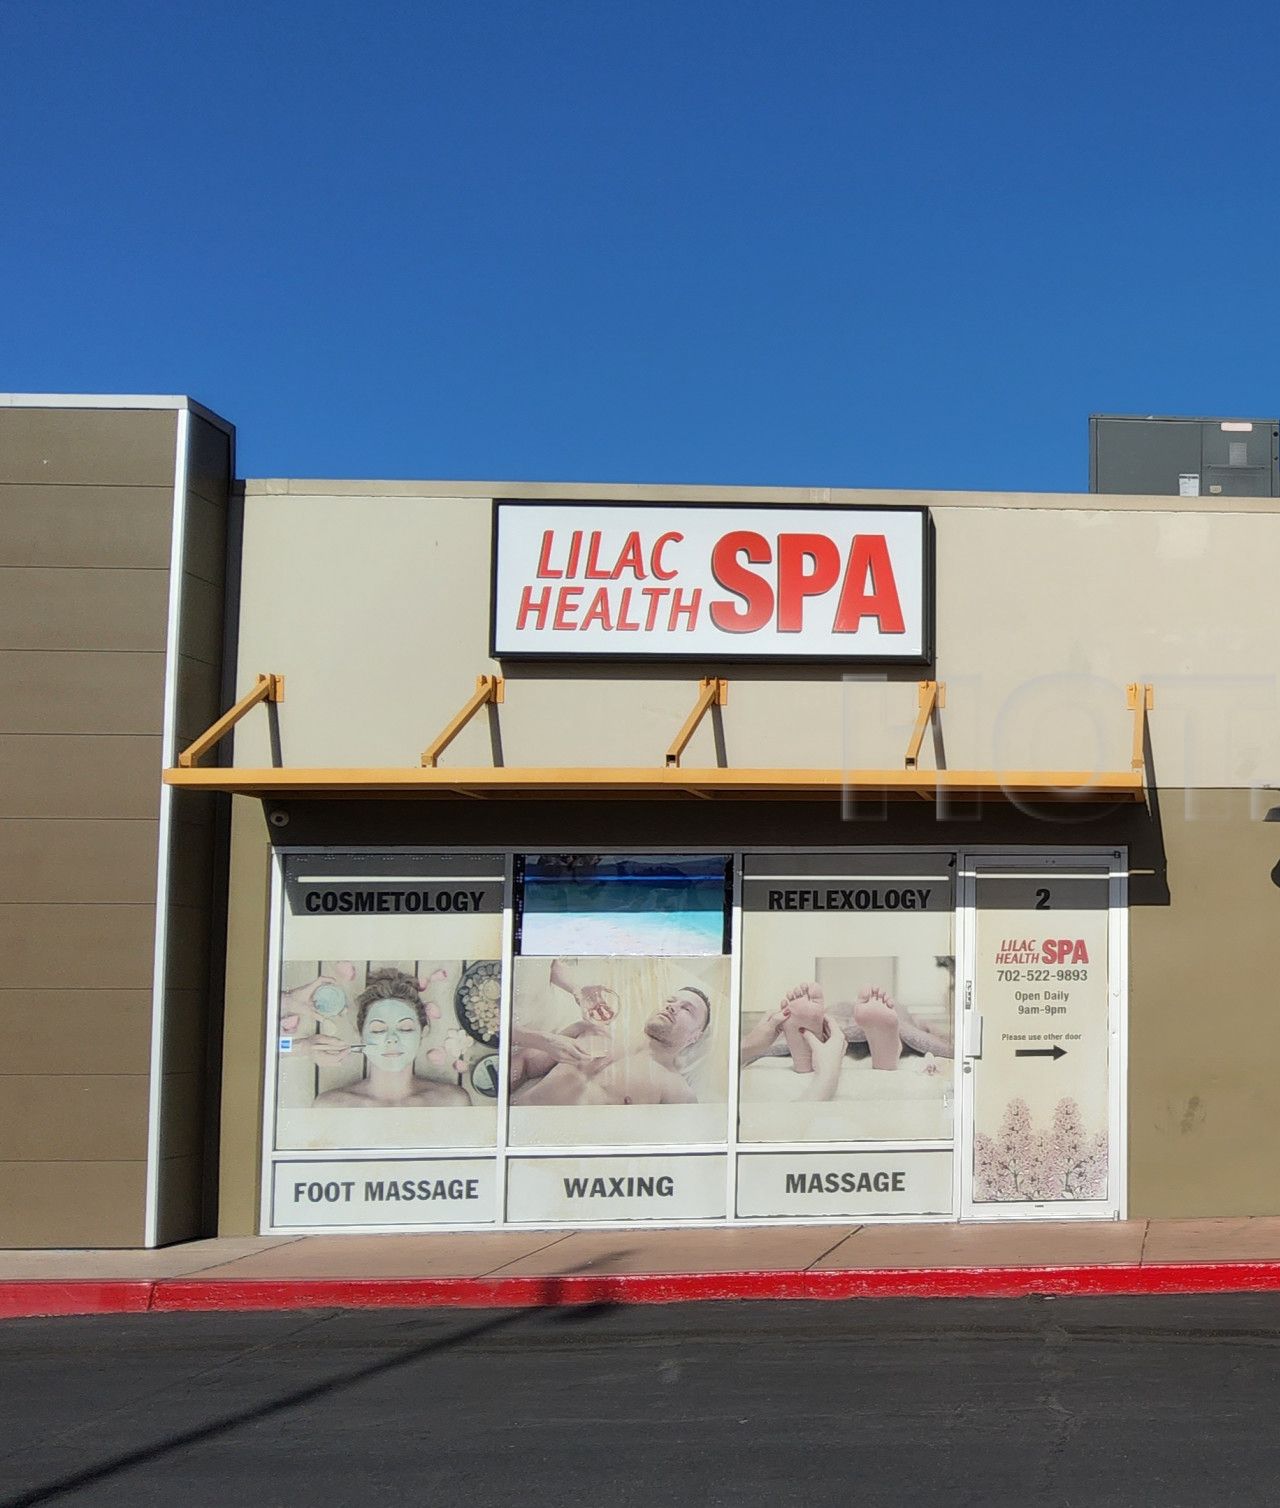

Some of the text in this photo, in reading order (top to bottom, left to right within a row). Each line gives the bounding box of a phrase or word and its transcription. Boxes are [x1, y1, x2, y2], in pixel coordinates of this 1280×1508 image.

[536, 530, 684, 580] LILAC
[709, 530, 906, 634] SPA
[516, 586, 702, 632] HEALTH
[304, 891, 486, 913] COSMETOLOGY
[768, 889, 932, 910] REFLEXOLOGY
[1035, 888, 1051, 910] 2
[1001, 939, 1036, 952] LILAC
[1042, 939, 1089, 964] SPA
[995, 953, 1040, 964] HEALTH
[997, 969, 1088, 982] 702-522-9893
[1015, 991, 1069, 1002] Open Daily
[1018, 1005, 1067, 1016] 9am-9pm
[1001, 1033, 1026, 1041] Please
[1043, 1033, 1063, 1041] other
[1065, 1033, 1082, 1041] door
[294, 1179, 479, 1202] FOOT MASSAGE
[563, 1175, 675, 1198] WAXING
[785, 1172, 907, 1193] MASSAGE
